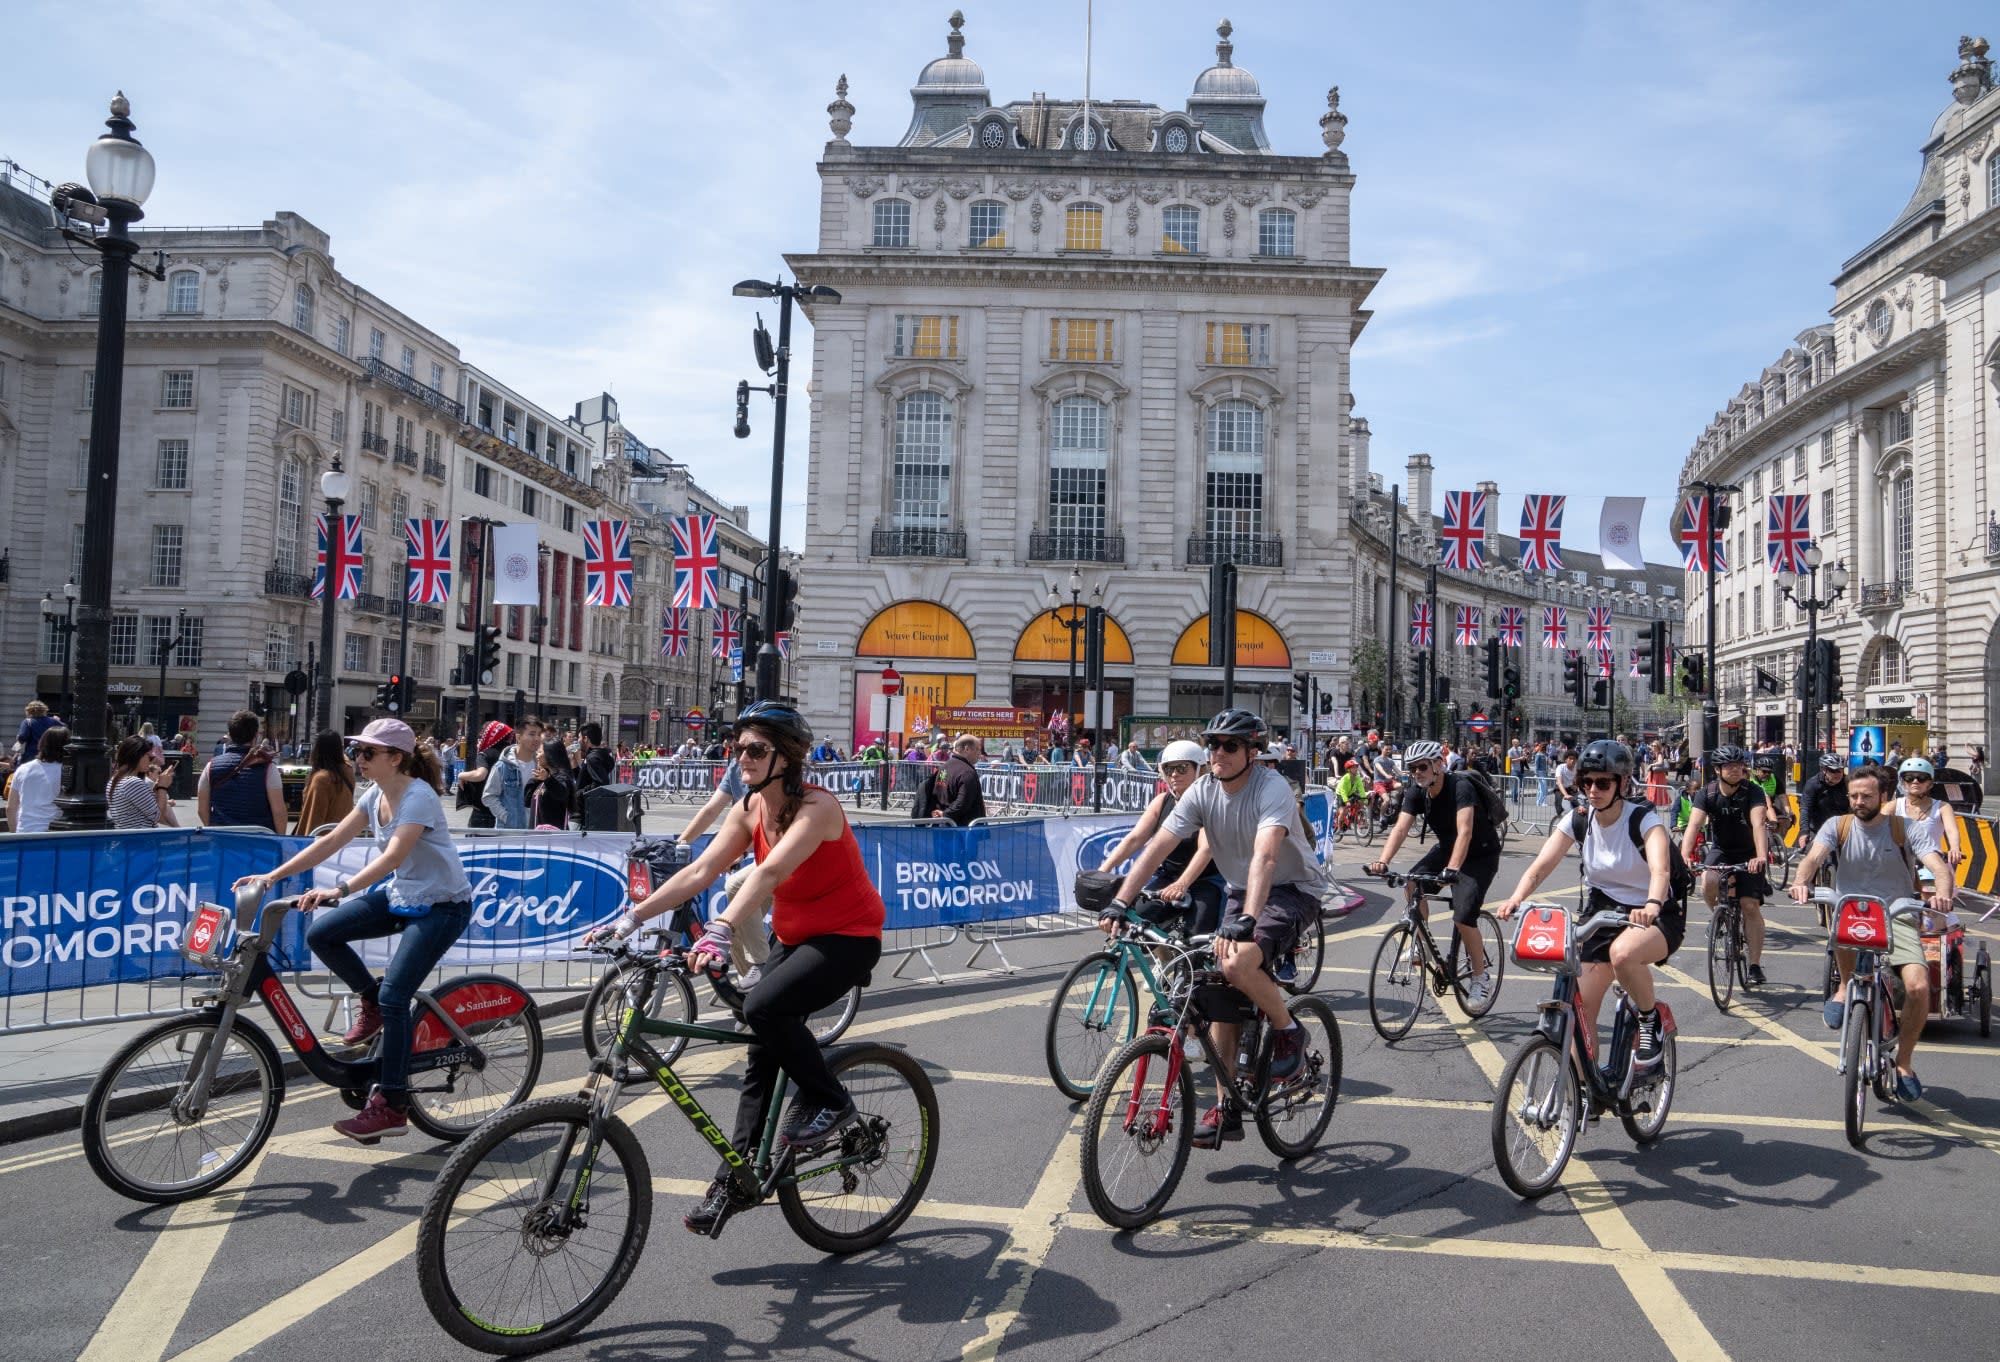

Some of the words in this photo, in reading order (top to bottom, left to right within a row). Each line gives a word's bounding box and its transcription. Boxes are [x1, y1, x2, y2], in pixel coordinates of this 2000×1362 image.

[885, 630, 910, 641] Veuve
[912, 631, 949, 642] Clicquot
[108, 682, 142, 692] ealbuzz
[896, 861, 966, 884] BRING
[967, 860, 1002, 881] ON
[0, 889, 121, 929] RING
[132, 883, 197, 915] ON
[462, 866, 582, 928] Ford
[897, 879, 1033, 911] TOMORROW
[0, 919, 237, 969] OMORR
[466, 994, 512, 1012] Santander
